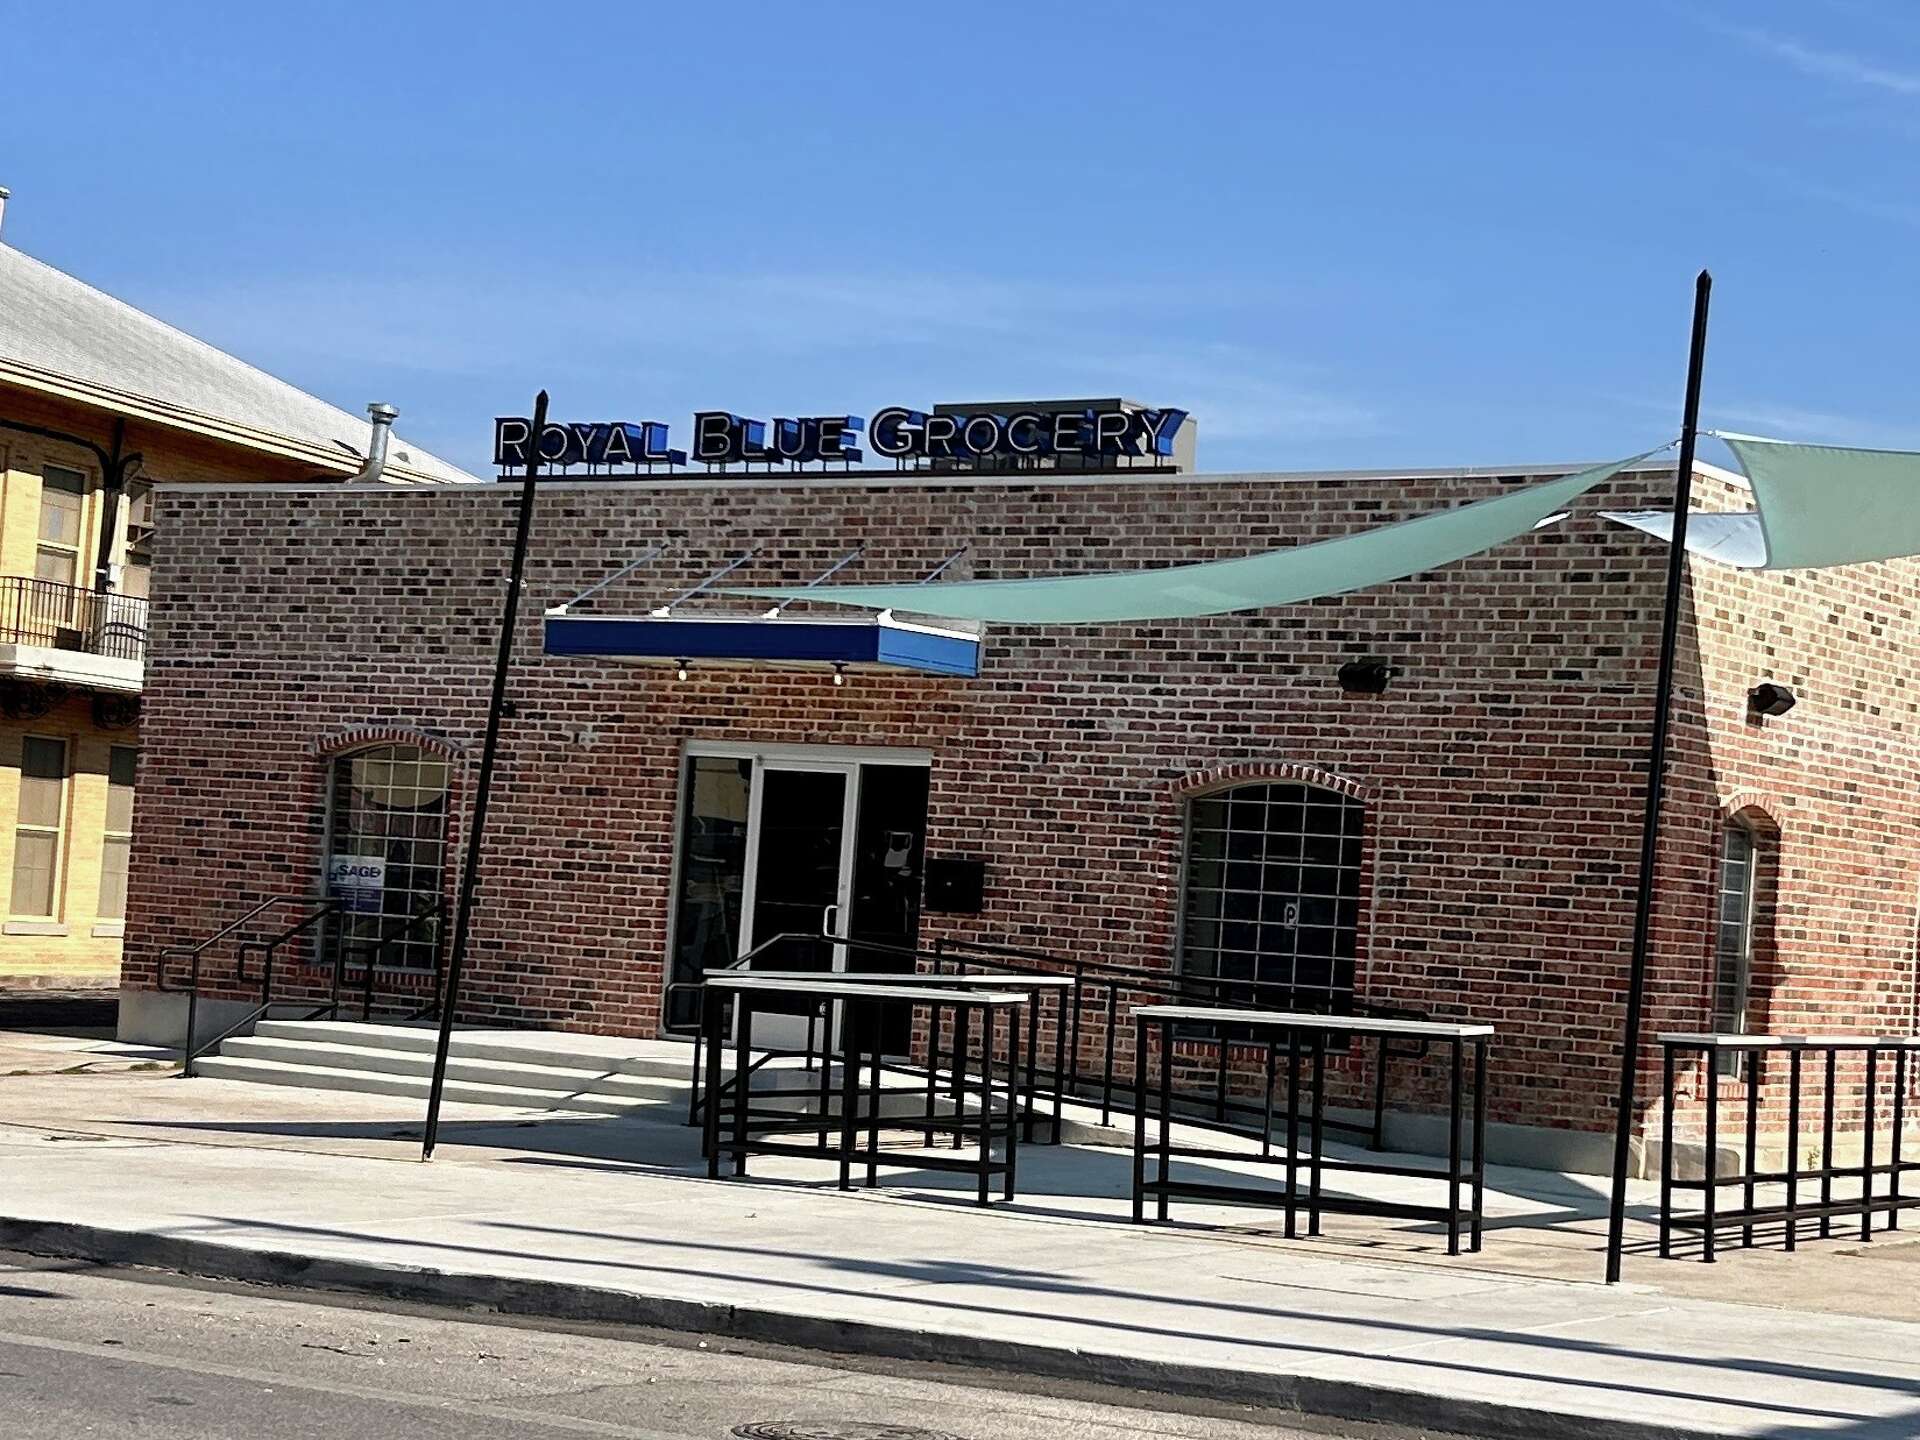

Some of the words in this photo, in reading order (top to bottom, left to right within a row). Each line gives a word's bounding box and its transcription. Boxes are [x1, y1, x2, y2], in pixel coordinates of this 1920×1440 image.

[494, 417, 684, 464] ROYAL
[693, 411, 862, 463] BLUE
[869, 406, 1186, 457] GROCERY
[339, 864, 382, 878] SAGE
